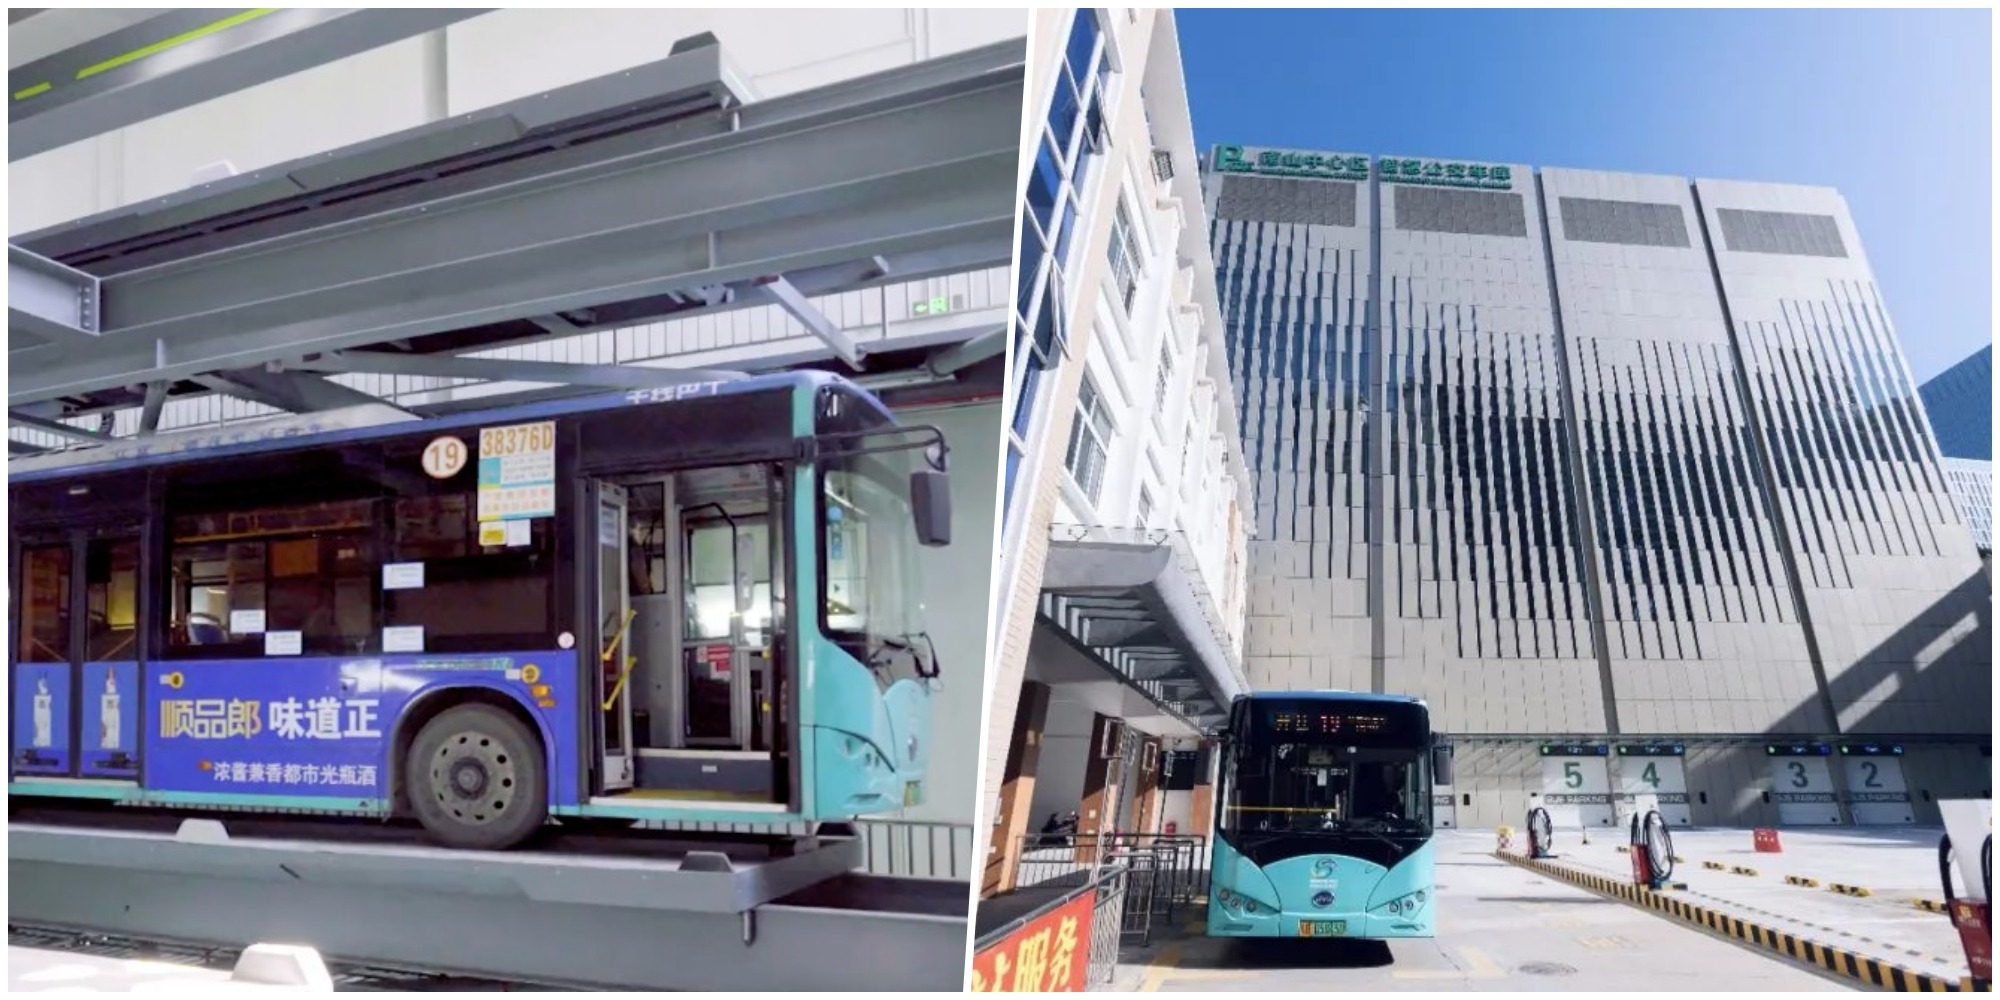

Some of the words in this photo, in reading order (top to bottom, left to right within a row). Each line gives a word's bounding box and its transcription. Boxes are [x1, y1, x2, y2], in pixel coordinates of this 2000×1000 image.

[482, 424, 553, 456] 38376D
[430, 442, 459, 471] 19
[160, 698, 262, 740] 顺品郎
[268, 697, 382, 740] 味道正
[213, 761, 378, 787] 浓酱兼香都市光瓶酒
[1563, 761, 1583, 789] 5
[1641, 761, 1661, 788] 4
[1787, 761, 1809, 788] 3
[1860, 761, 1883, 788] 2
